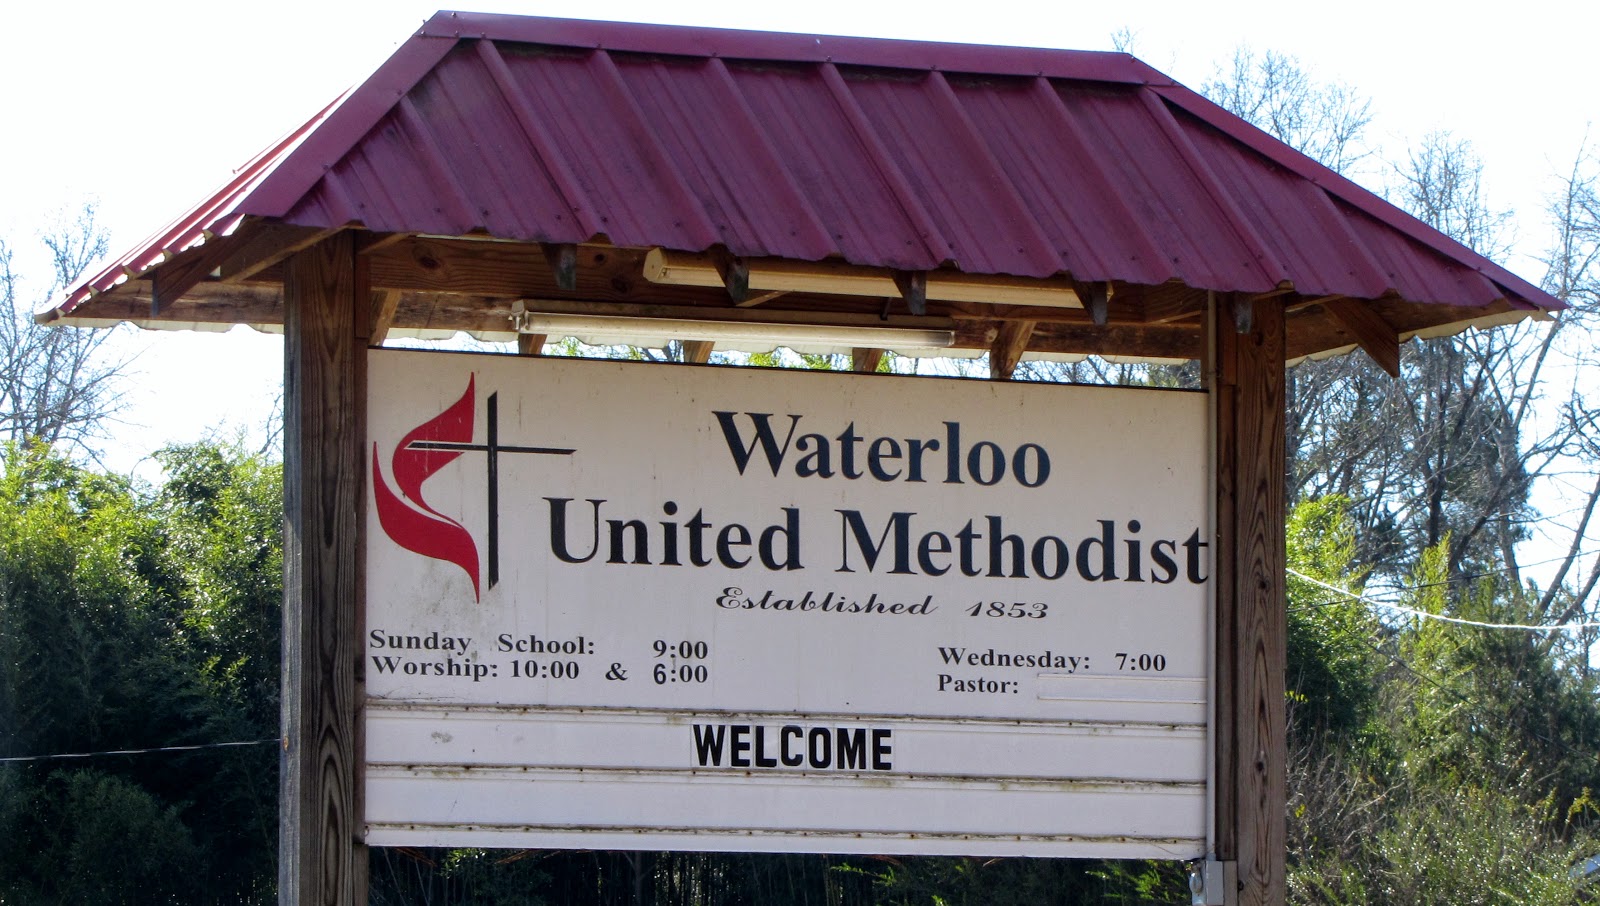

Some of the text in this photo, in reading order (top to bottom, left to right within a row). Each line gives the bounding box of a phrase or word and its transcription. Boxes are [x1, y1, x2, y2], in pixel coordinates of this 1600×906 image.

[712, 411, 1050, 487] Waterloo
[542, 497, 1208, 584] United Methodist
[715, 586, 1049, 619] Established 1853
[370, 630, 707, 659] Sunday School: 9:00
[939, 647, 1165, 673] Wednesday: 7:00
[371, 655, 707, 684] Worship: 10:00 & 6:00
[939, 675, 1017, 693] Pastor:
[693, 725, 892, 770] WELCOME
